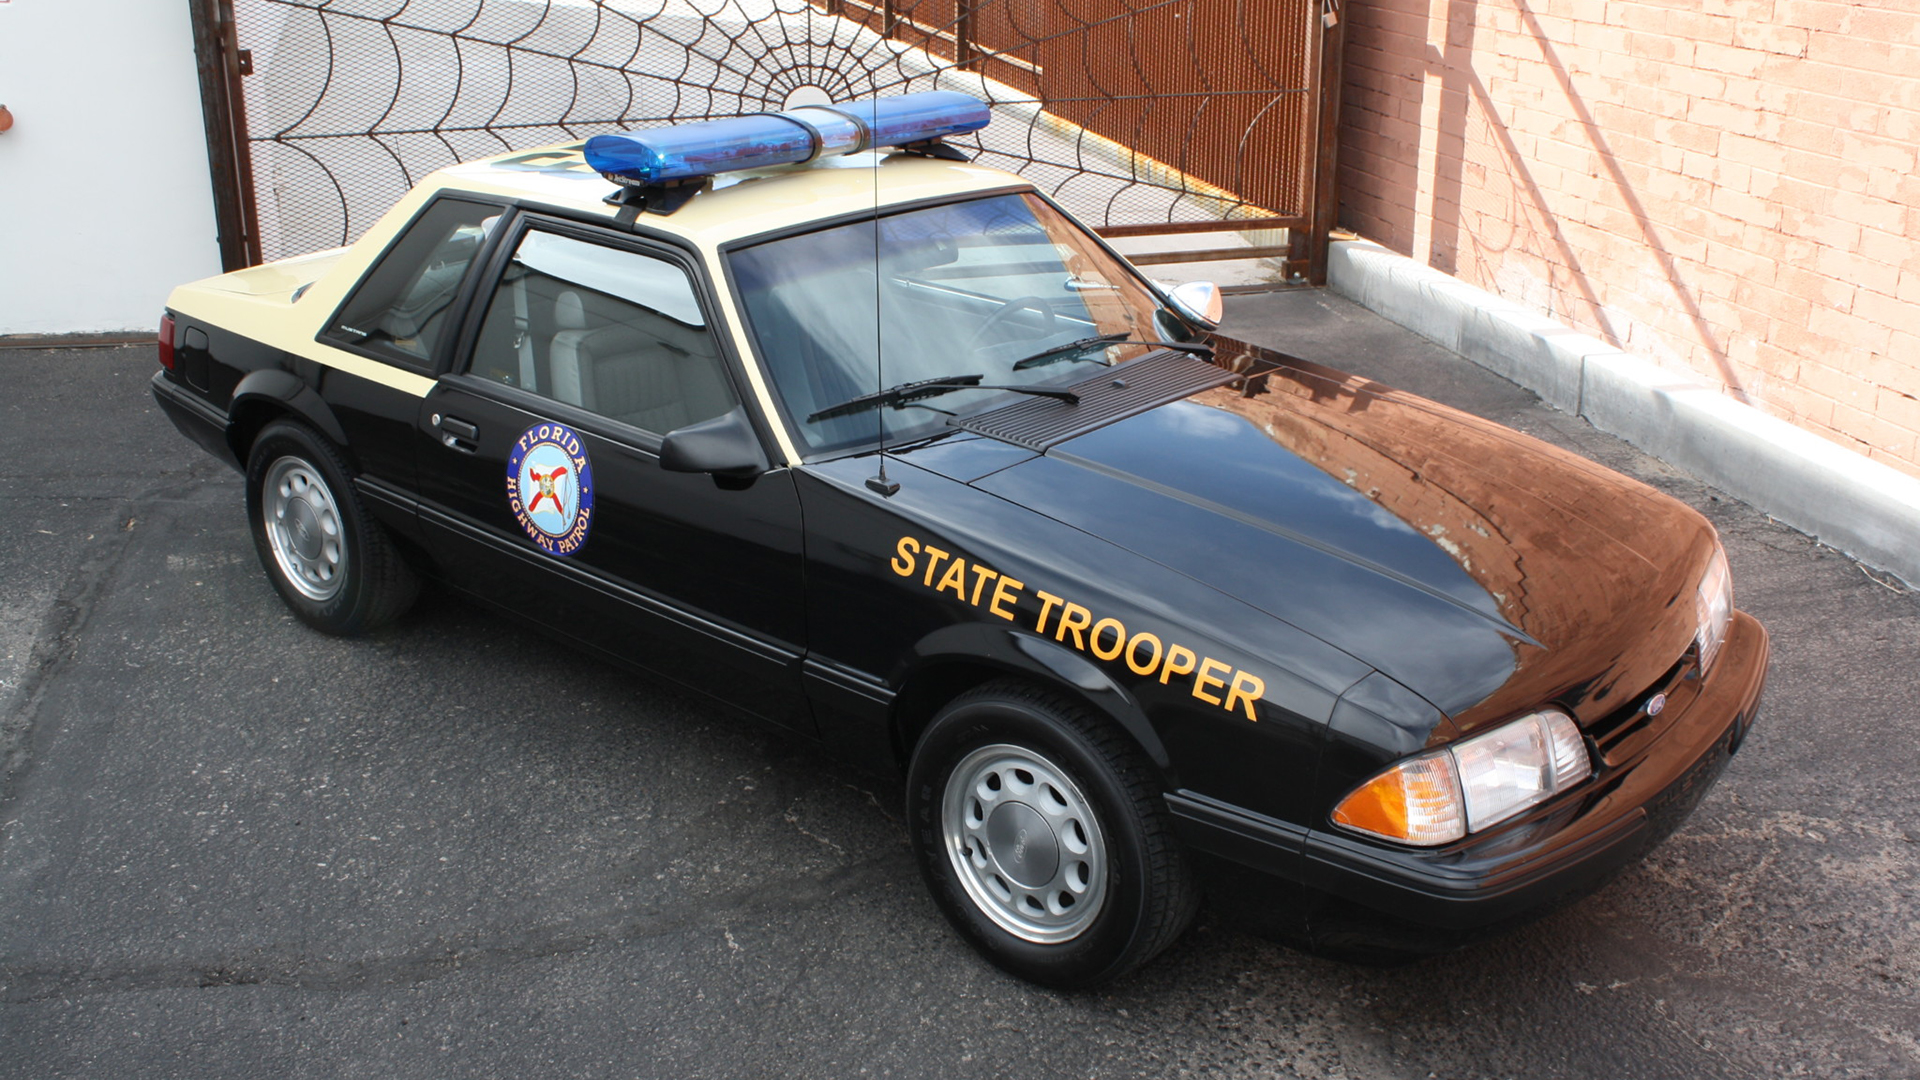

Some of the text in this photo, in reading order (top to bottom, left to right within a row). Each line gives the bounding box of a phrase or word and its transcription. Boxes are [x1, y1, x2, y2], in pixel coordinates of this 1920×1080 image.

[518, 425, 587, 474] FLORIDA
[506, 476, 591, 554] HIGHWAY PATROL
[890, 536, 1266, 722] STATE TROOPER
